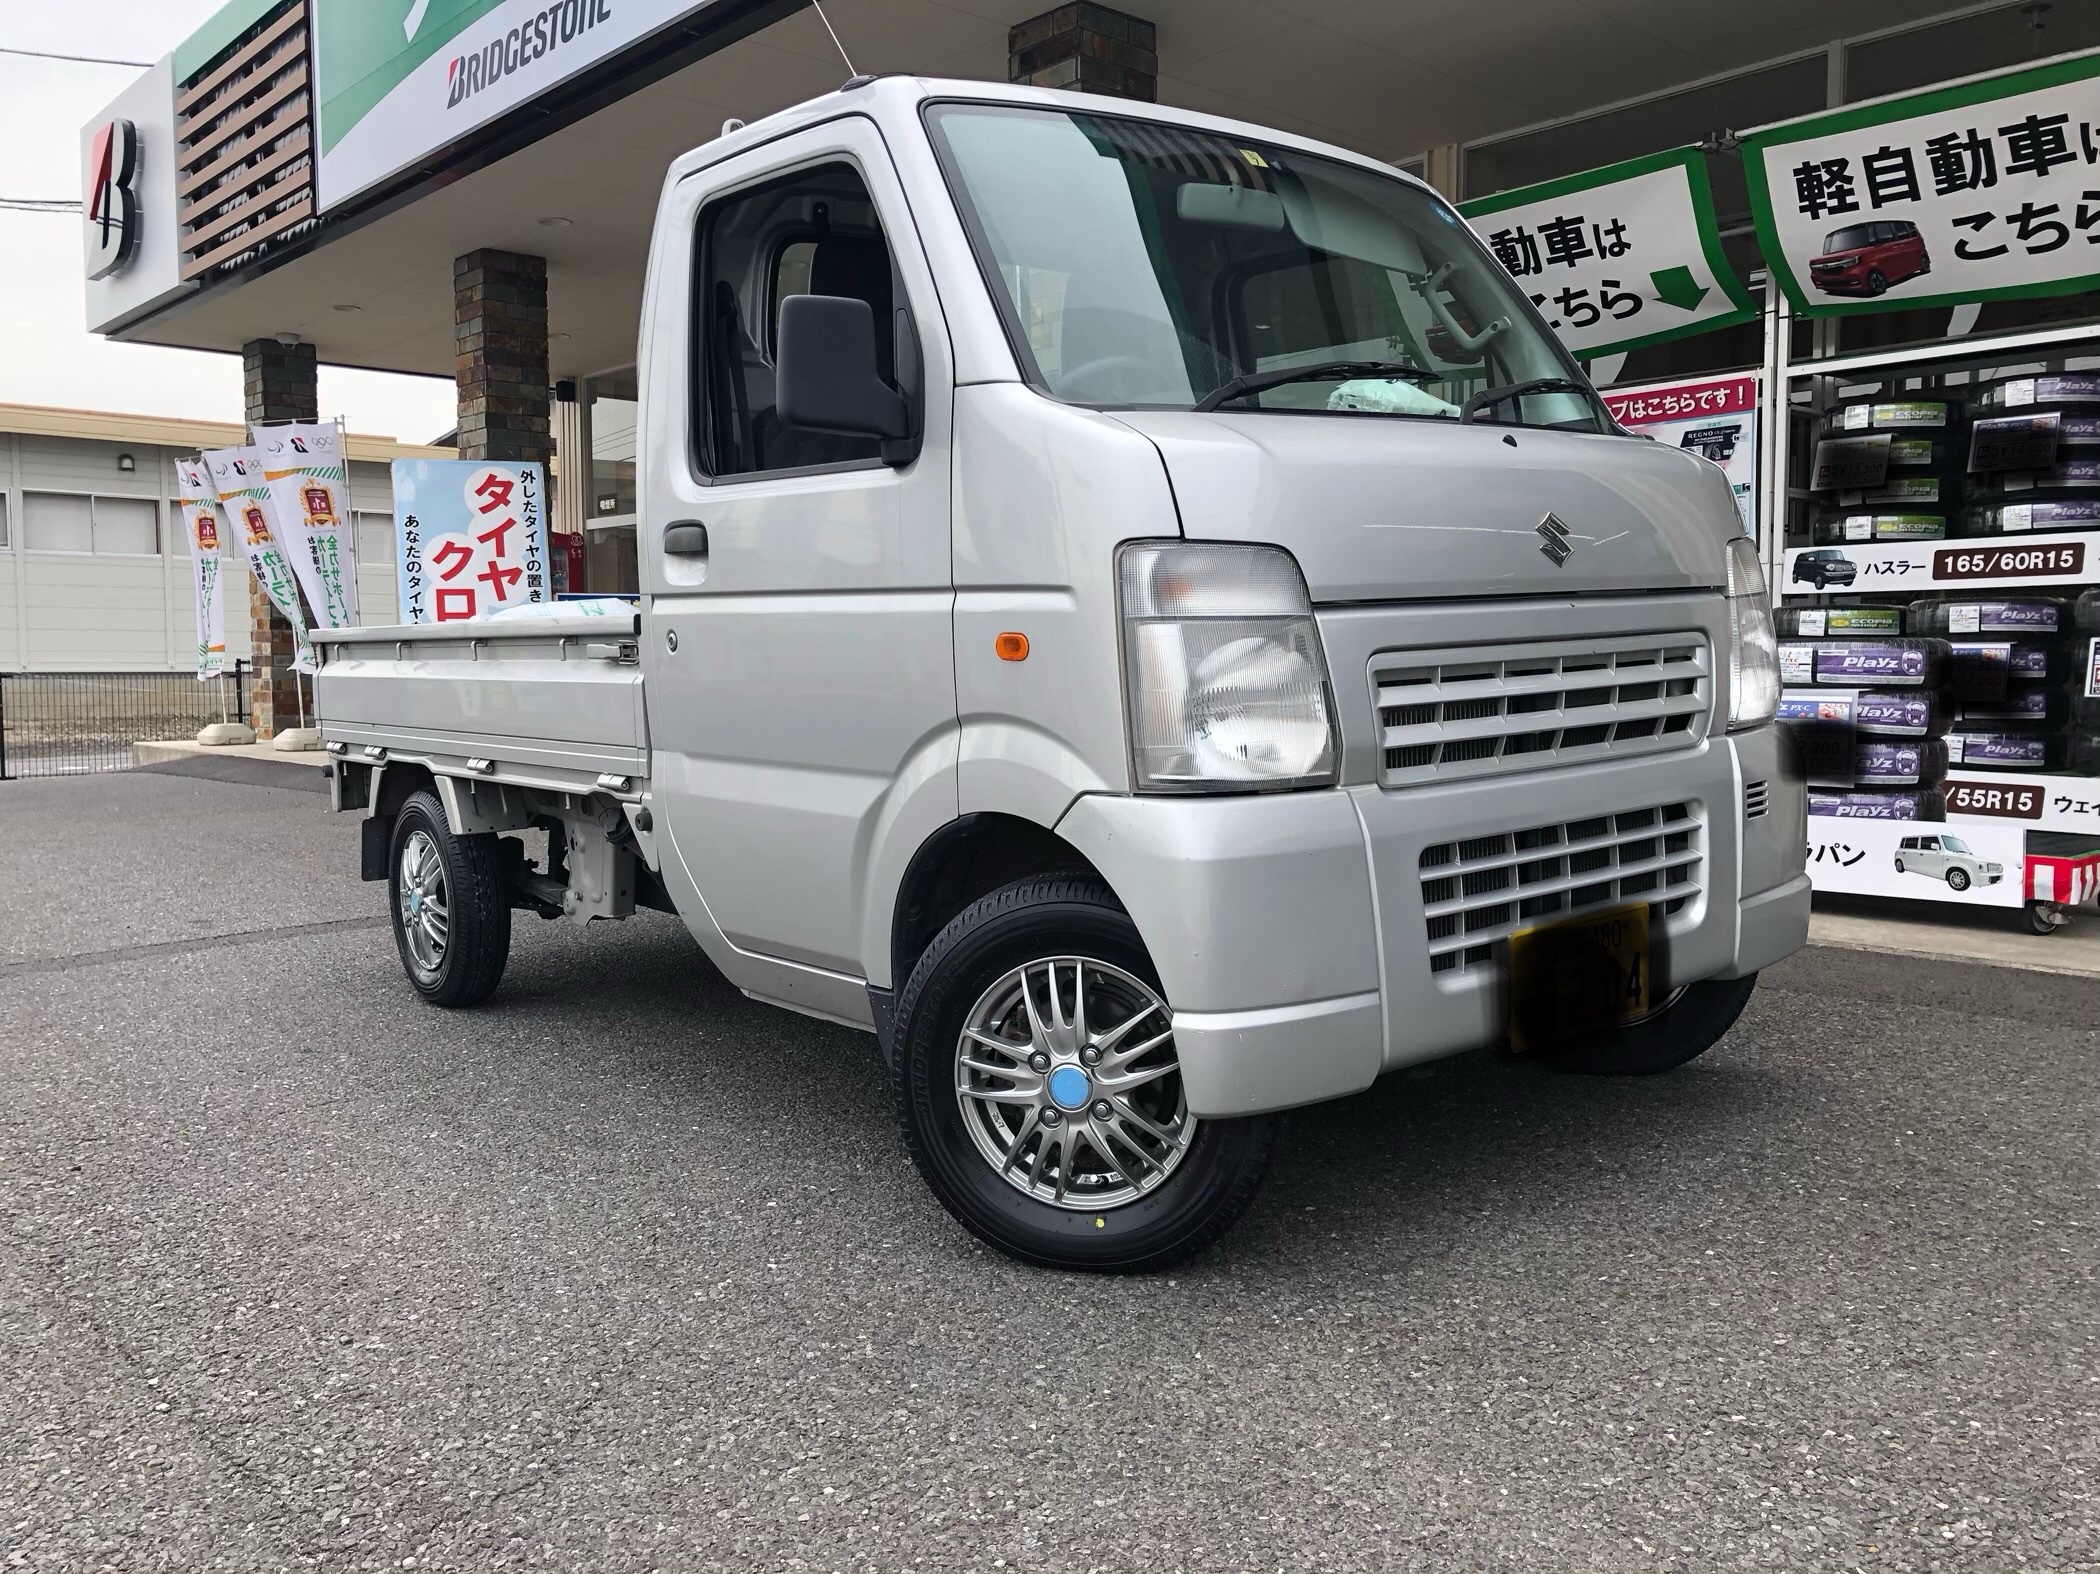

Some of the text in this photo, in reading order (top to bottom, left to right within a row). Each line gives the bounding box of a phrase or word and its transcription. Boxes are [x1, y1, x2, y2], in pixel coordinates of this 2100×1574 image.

[1609, 385, 1745, 421] プはこちらです！
[475, 473, 524, 602] タイヤ
[520, 469, 543, 603] 外したタイヤの置き
[404, 514, 424, 624] あなたのタイヤ
[1864, 559, 1926, 575] ハスラー
[1944, 550, 2074, 573] 165/60R15
[2001, 610, 2041, 620] Playz
[1842, 656, 1899, 668] Playz
[1835, 805, 1891, 817] Playz
